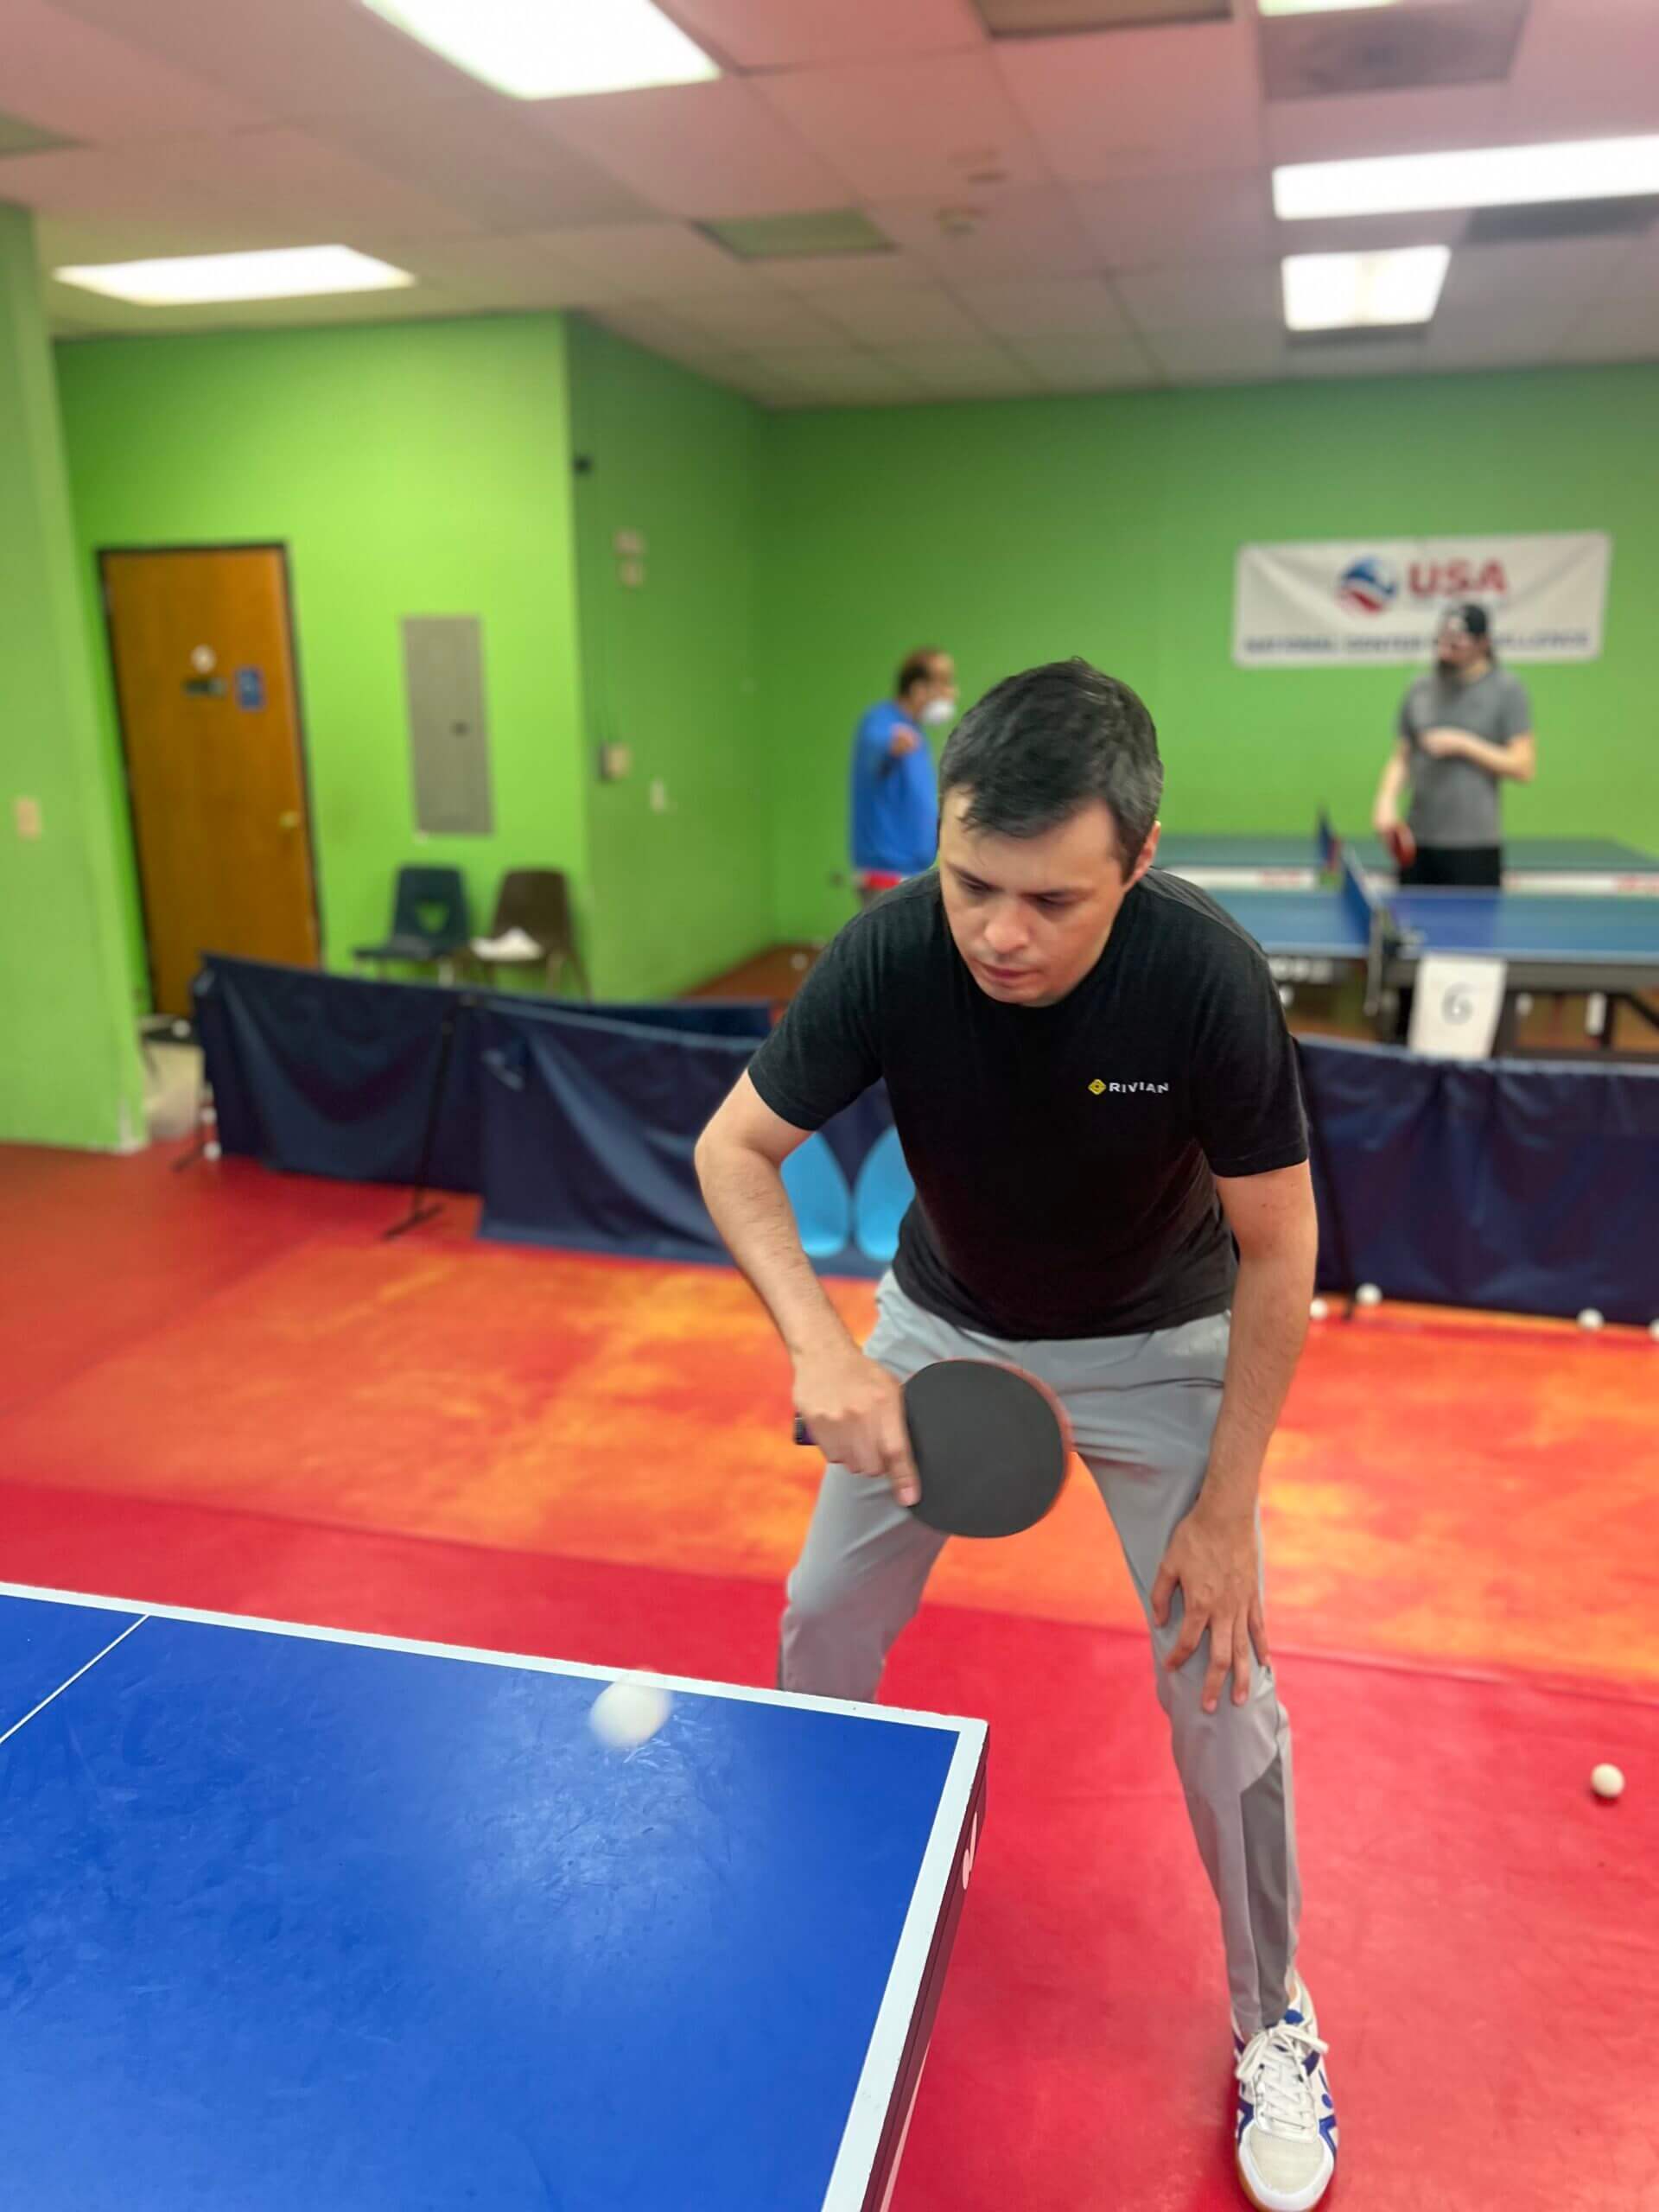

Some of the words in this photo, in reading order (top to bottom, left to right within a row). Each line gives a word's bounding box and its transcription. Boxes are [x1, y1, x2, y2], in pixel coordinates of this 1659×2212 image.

[1408, 560, 1507, 597] USA
[1442, 983, 1472, 1024] 6
[1109, 1081, 1169, 1094] RIVIAN
